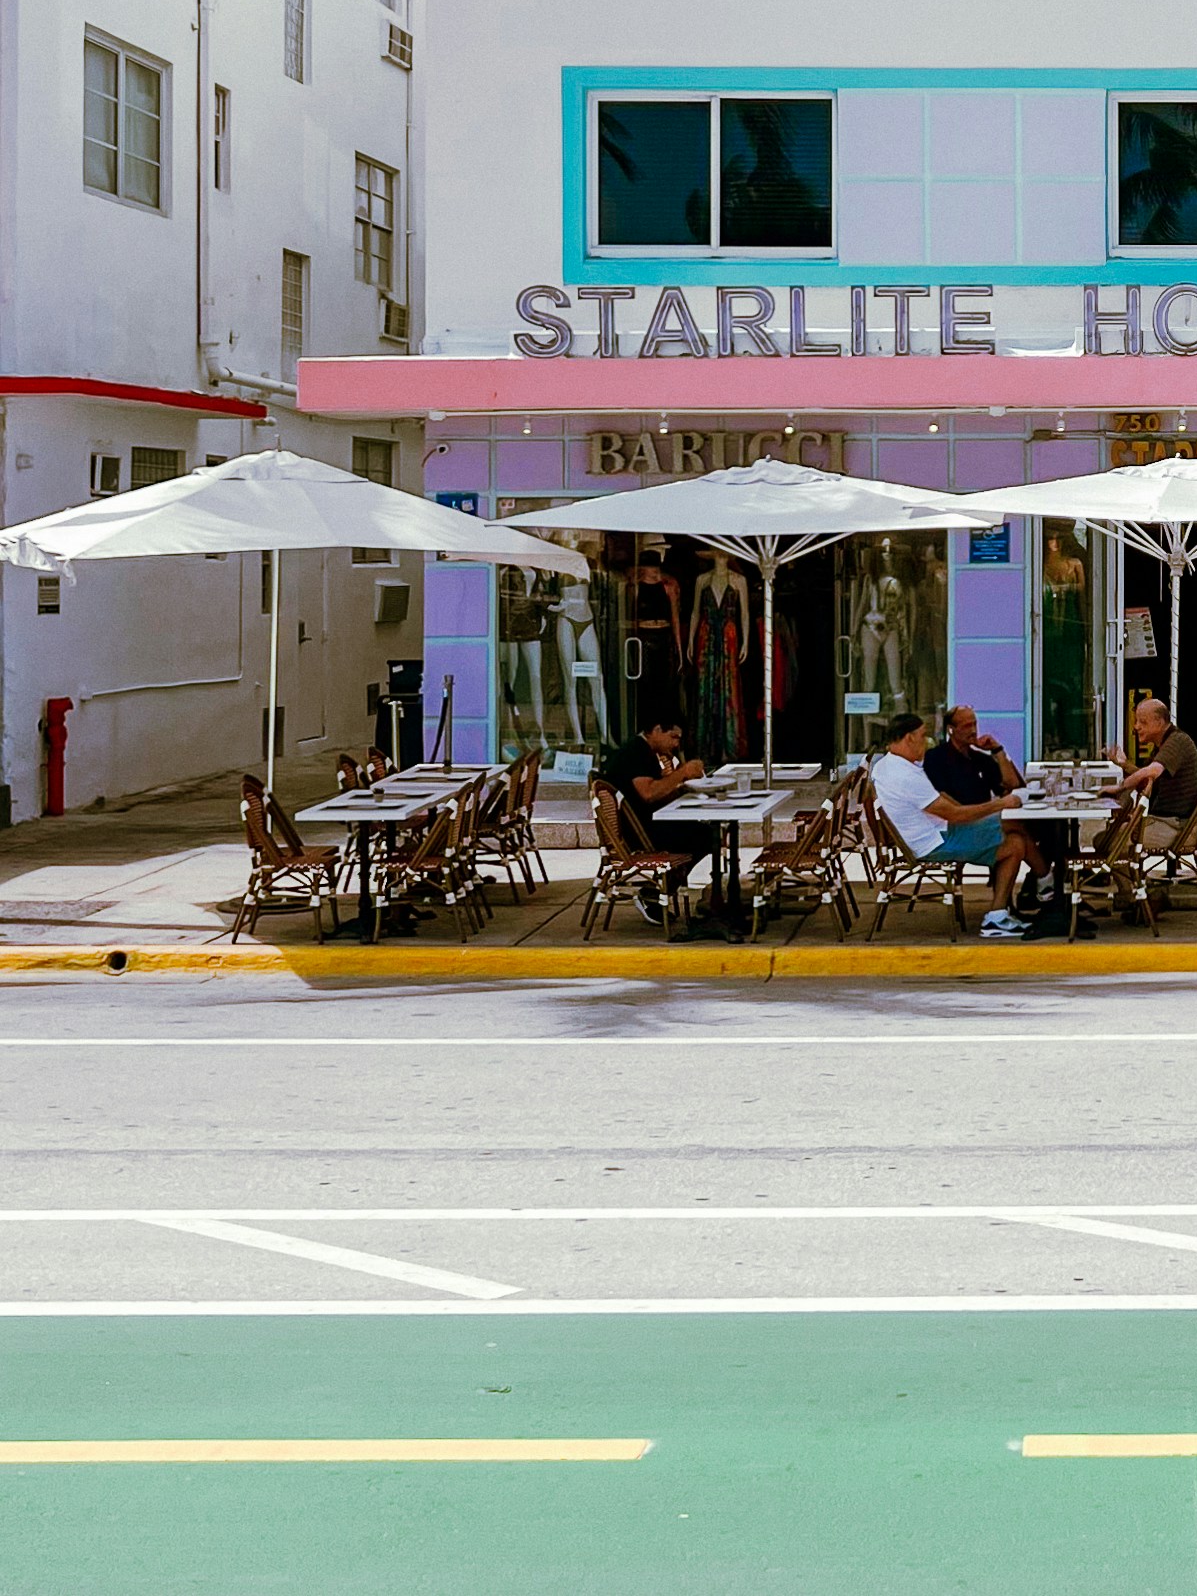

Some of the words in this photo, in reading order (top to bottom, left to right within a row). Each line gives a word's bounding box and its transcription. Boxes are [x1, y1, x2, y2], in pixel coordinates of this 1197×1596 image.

[514, 284, 996, 358] STARLITE
[1112, 414, 1160, 432] 750
[586, 431, 850, 474] BARUCCI
